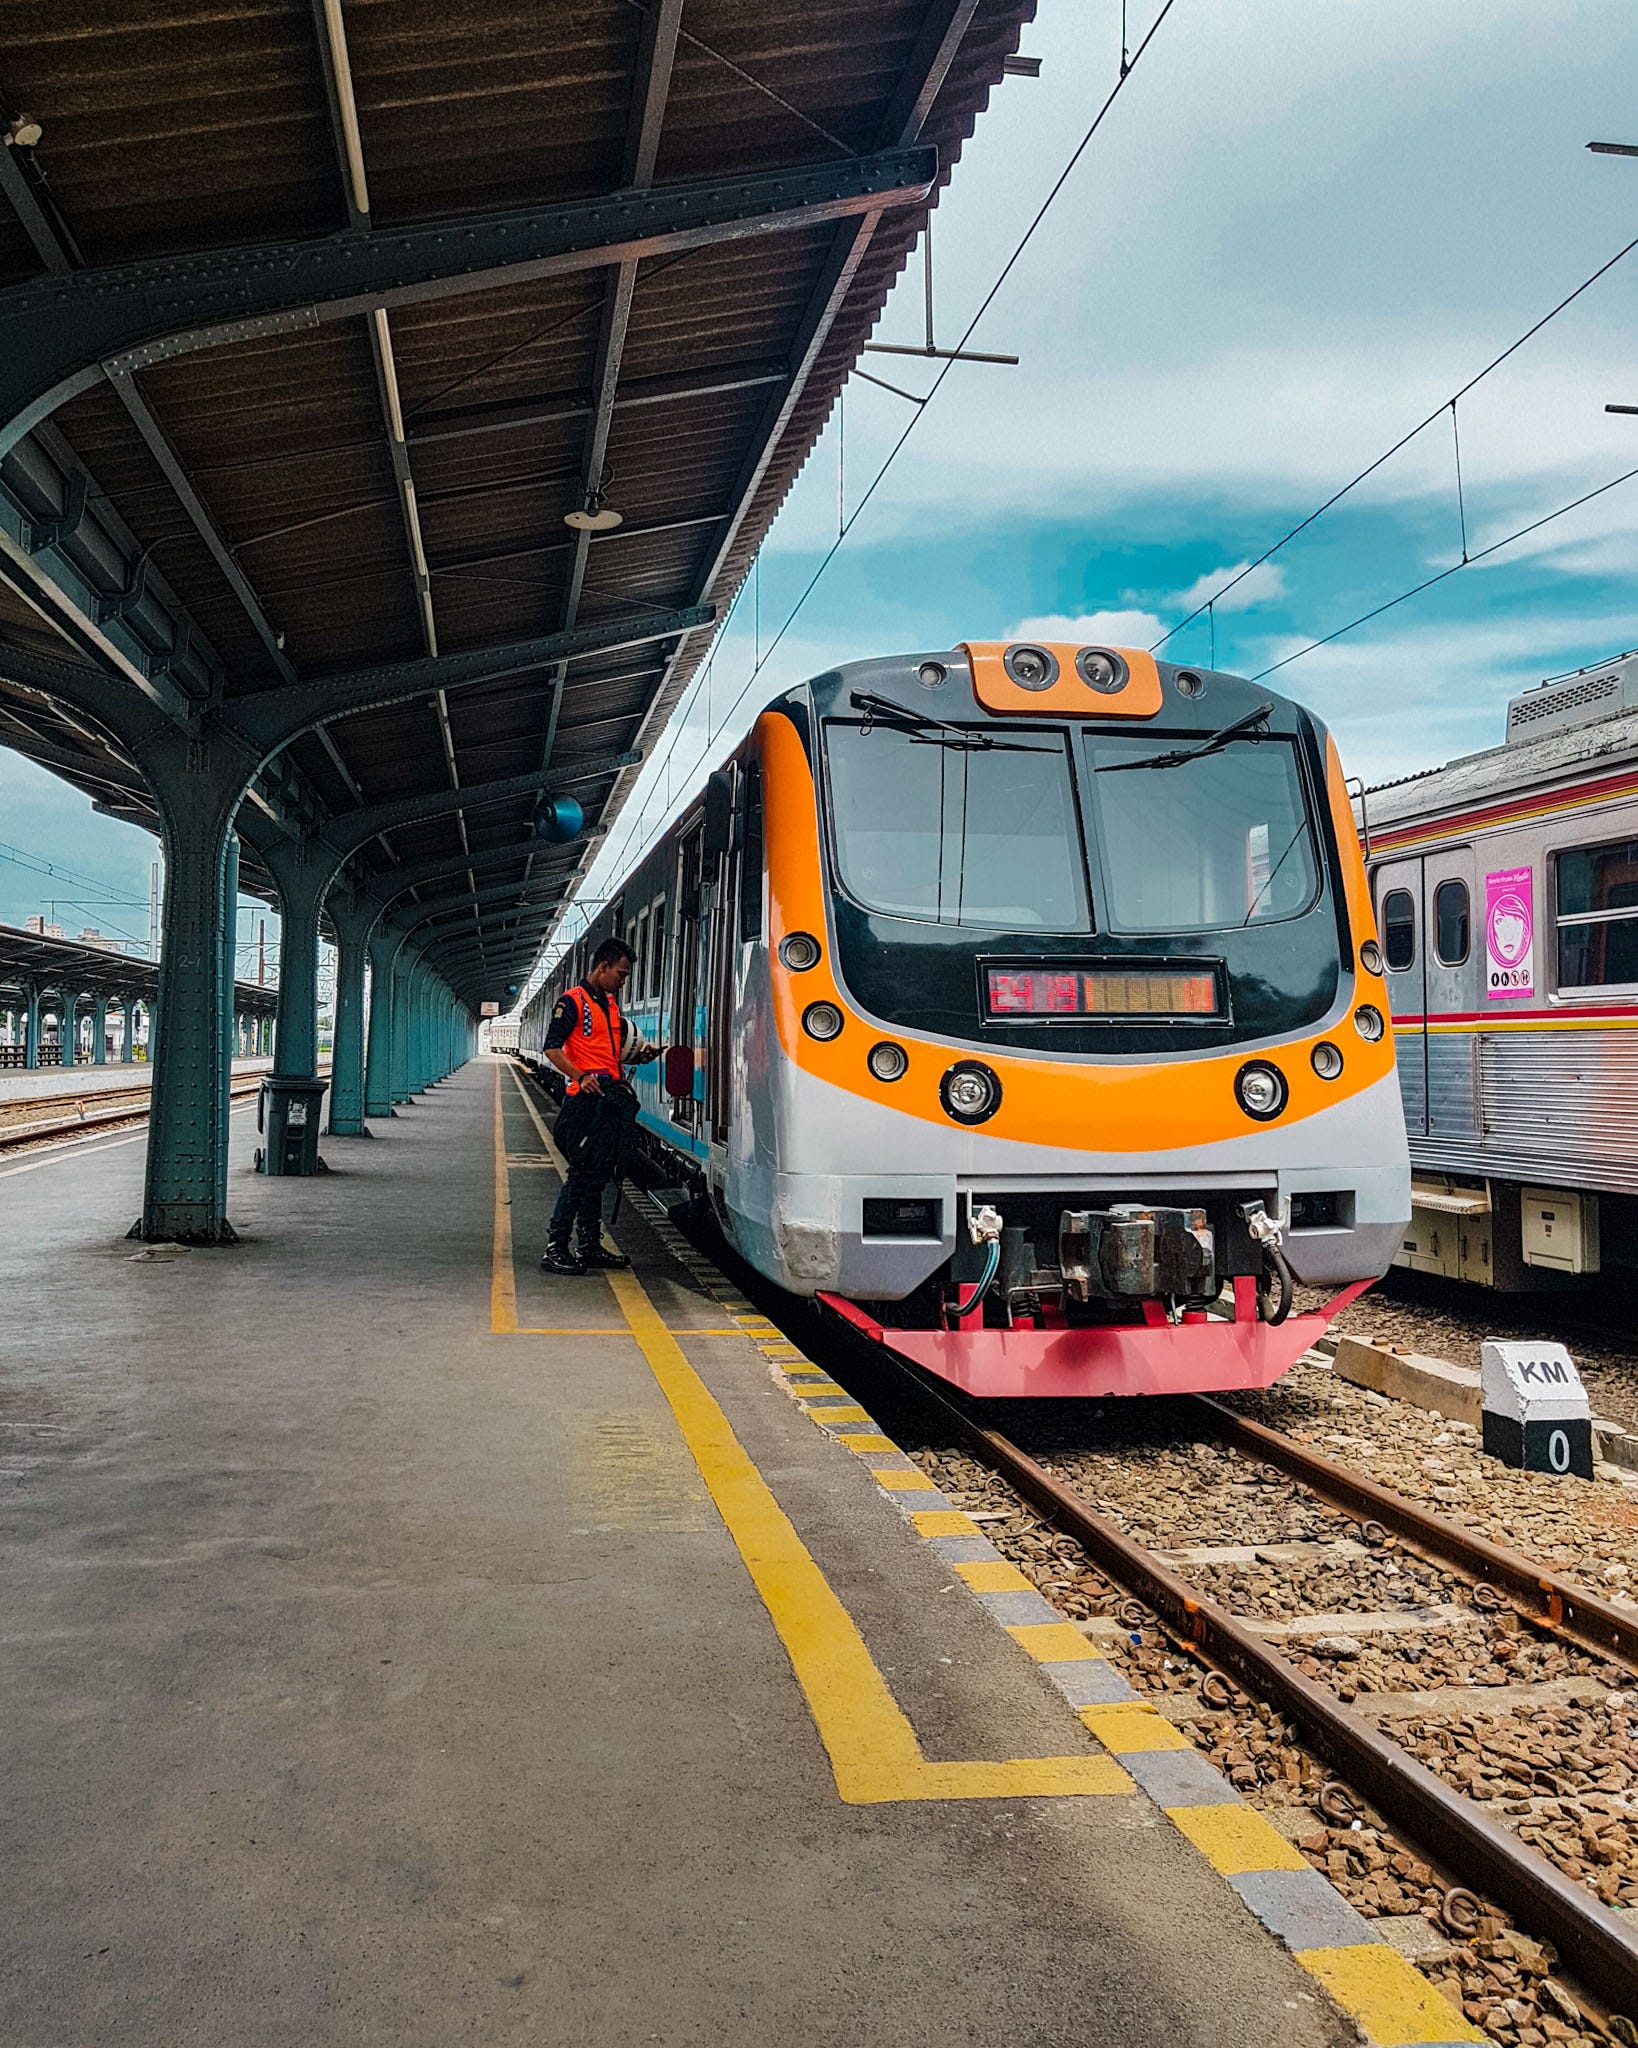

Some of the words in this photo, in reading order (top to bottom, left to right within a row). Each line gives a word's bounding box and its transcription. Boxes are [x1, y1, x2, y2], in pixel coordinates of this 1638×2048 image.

[991, 976, 1077, 1011] 2419
[1517, 1361, 1569, 1383] KM
[1549, 1429, 1570, 1472] 0
